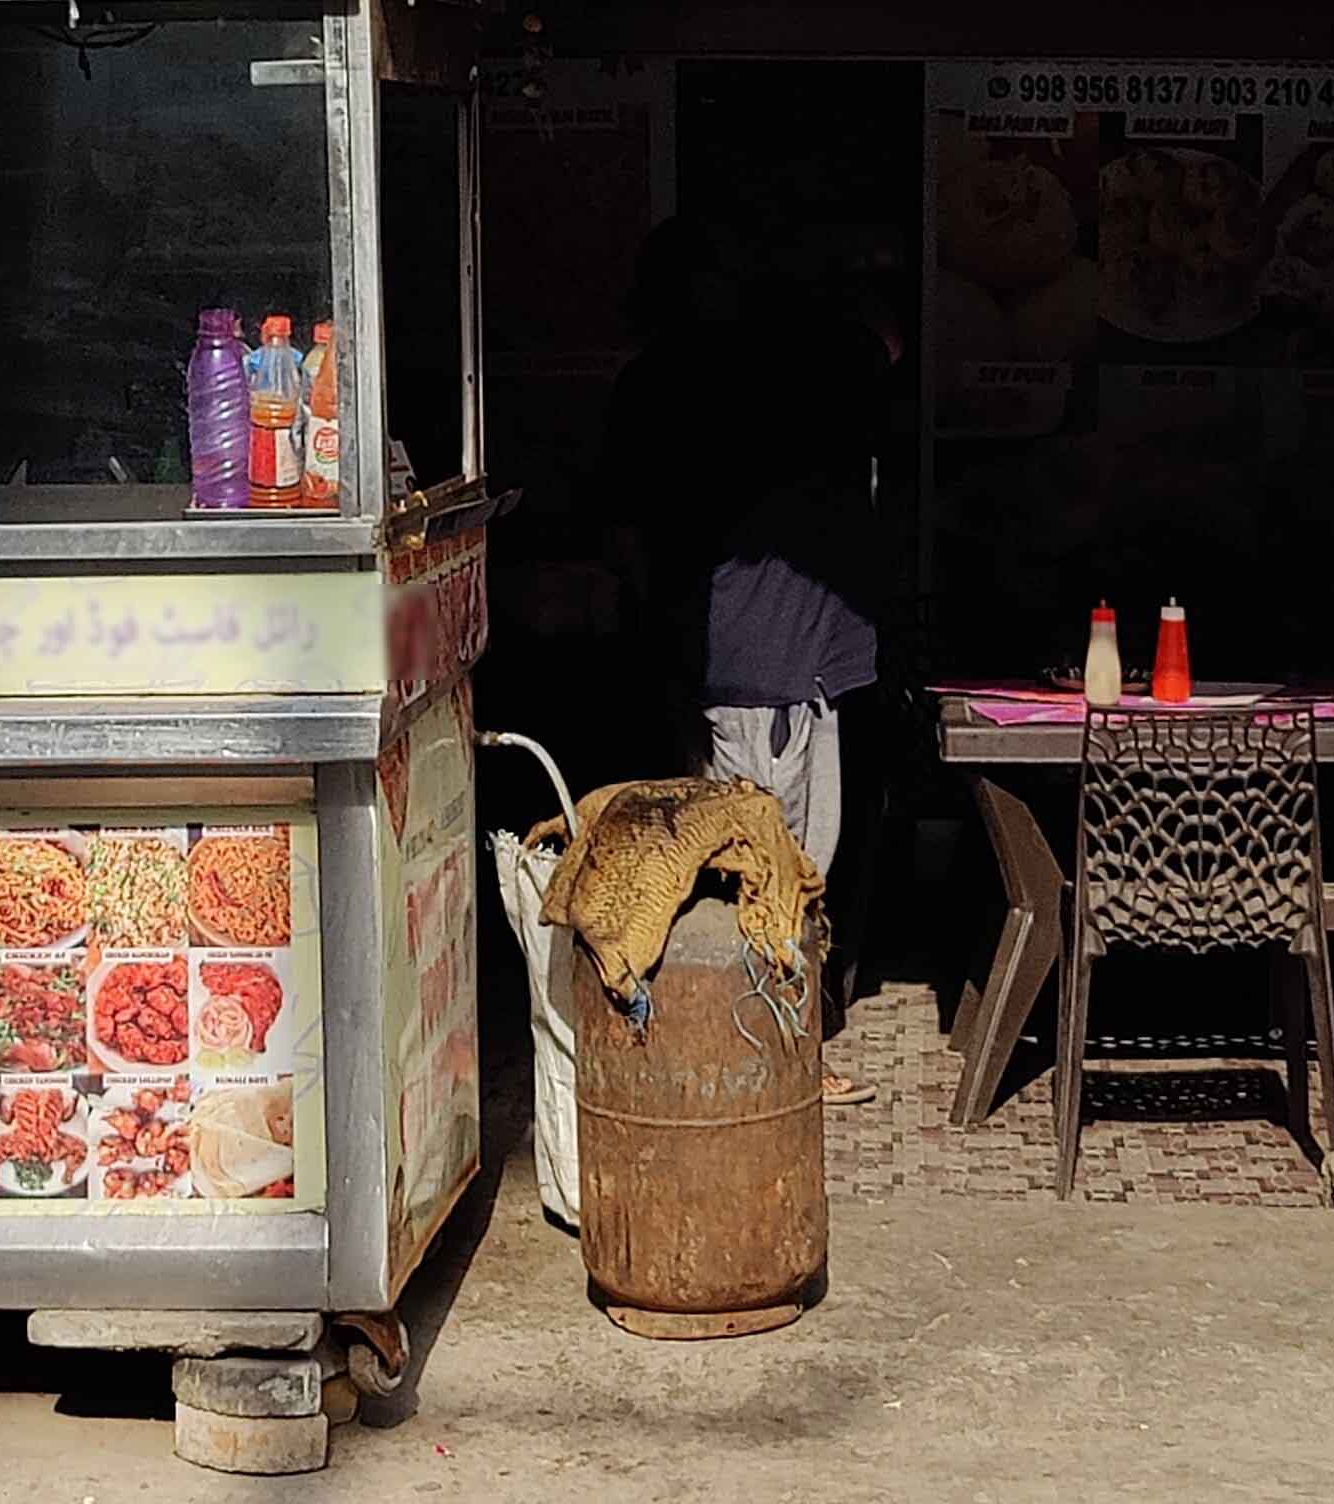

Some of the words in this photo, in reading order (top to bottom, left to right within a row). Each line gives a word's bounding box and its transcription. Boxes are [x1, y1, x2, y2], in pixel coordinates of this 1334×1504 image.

[1020, 75, 1065, 104] 998
[1074, 75, 1120, 104] 956
[1126, 76, 1189, 104] 8137
[1210, 77, 1258, 107] 903
[1264, 78, 1311, 107] 210
